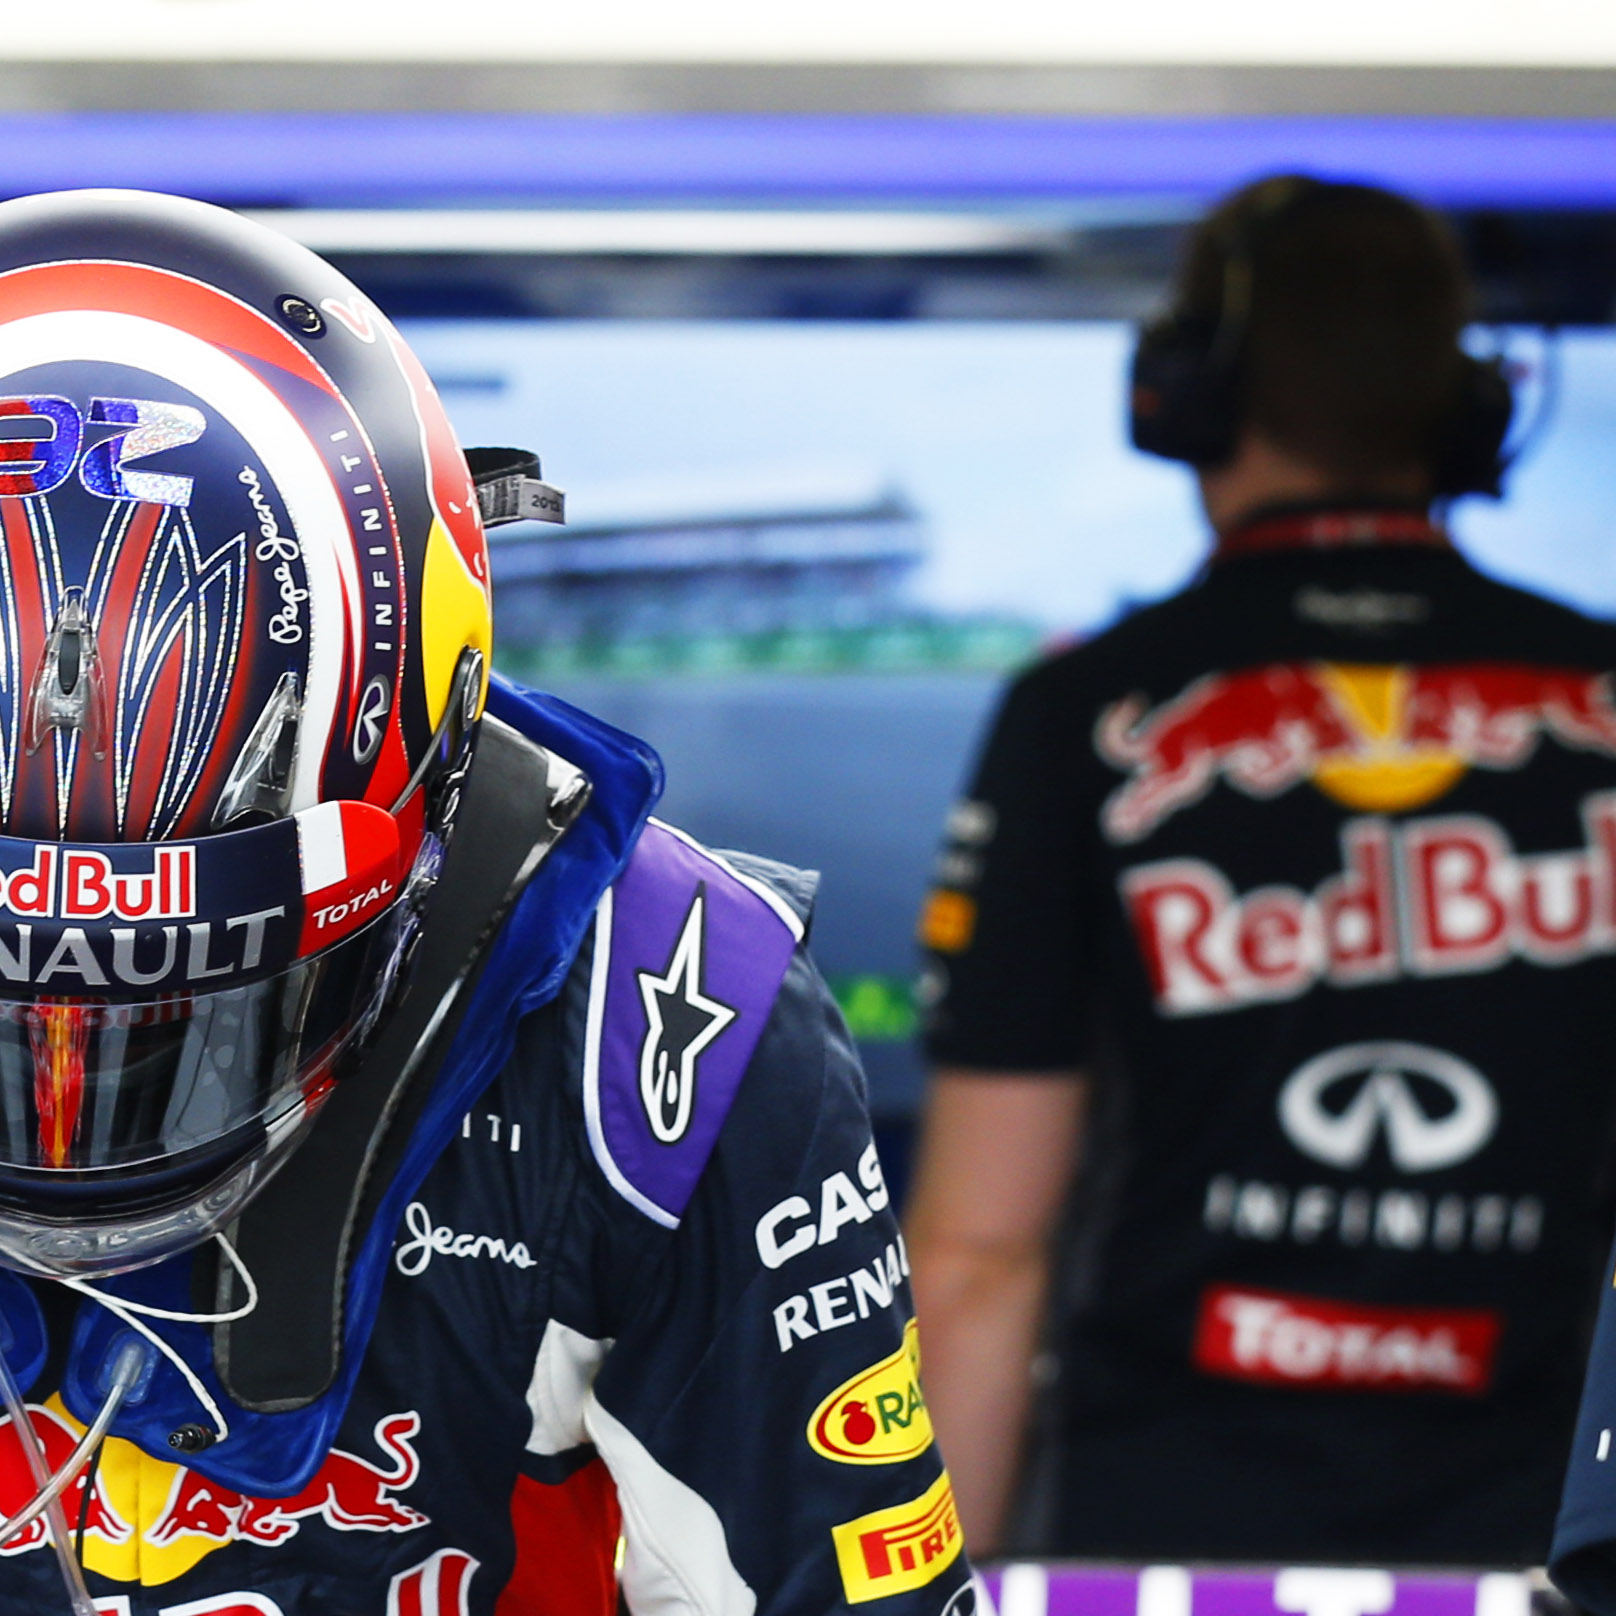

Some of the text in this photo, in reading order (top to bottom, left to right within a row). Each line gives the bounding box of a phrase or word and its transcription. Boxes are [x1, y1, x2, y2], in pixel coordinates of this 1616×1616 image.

[330, 429, 395, 652] INFINITI
[61, 845, 196, 921] Bull
[312, 878, 394, 930] TOTAL
[1119, 815, 1398, 1018] Red
[1399, 786, 1616, 978] Bul
[395, 1201, 537, 1276] Jeans
[755, 1141, 890, 1269] CAS
[1204, 1174, 1545, 1254] INFINITI
[1218, 1296, 1474, 1382] TOTAL
[858, 1487, 957, 1580] PIRE
